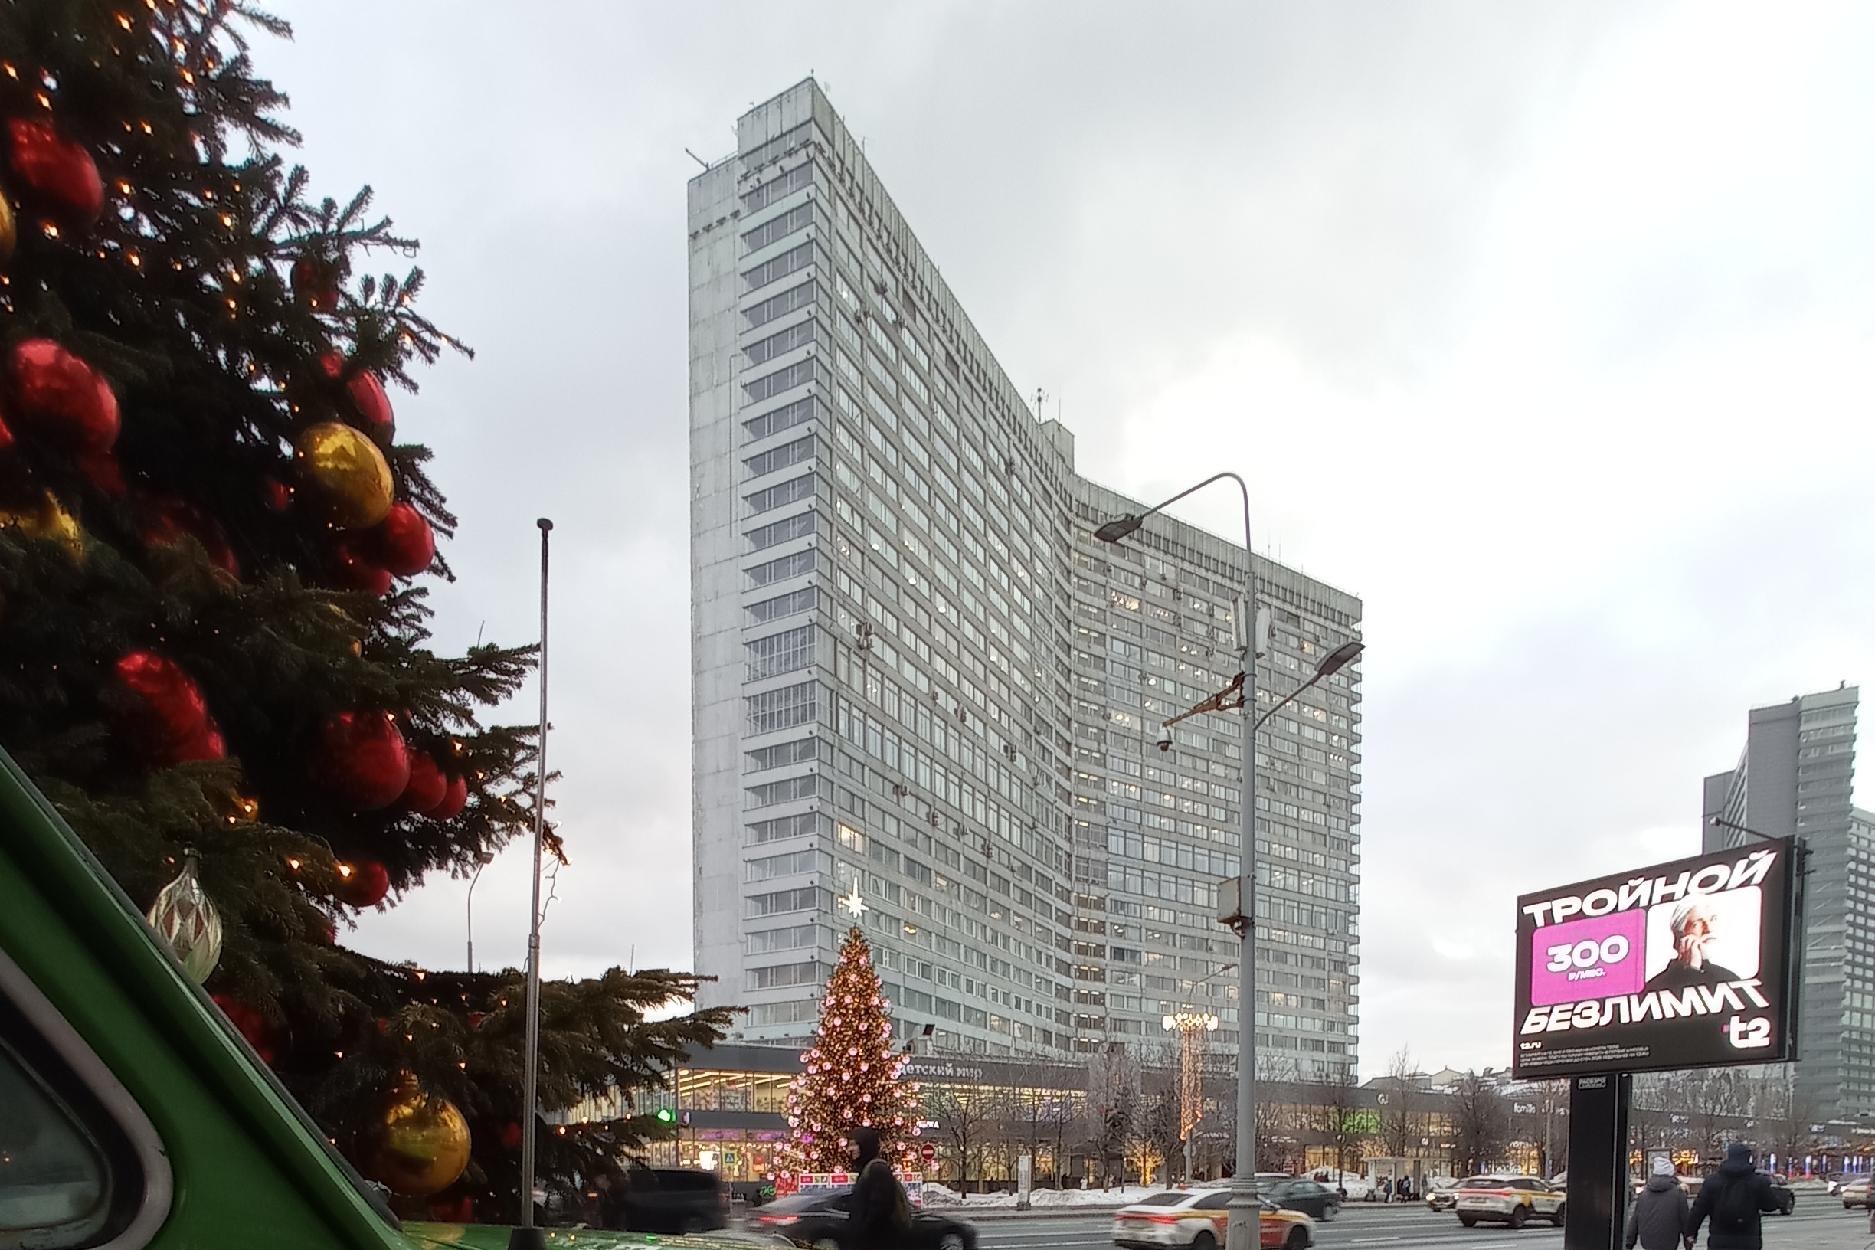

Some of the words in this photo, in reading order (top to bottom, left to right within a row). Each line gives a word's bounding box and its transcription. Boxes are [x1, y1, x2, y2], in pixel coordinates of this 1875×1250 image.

[1523, 850, 1777, 927] ТРОЙНОЙ
[1547, 935, 1629, 972] 300
[1520, 979, 1769, 1035] БЕЗЛИМИТ
